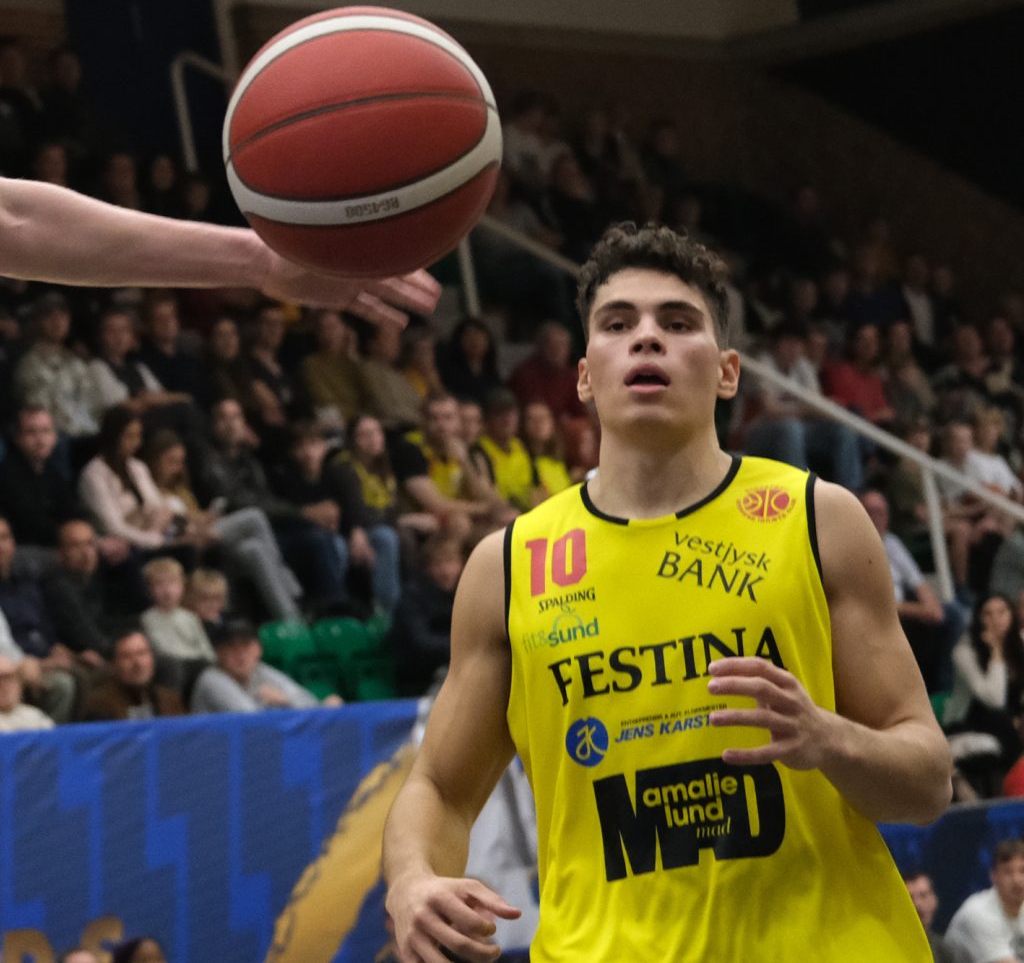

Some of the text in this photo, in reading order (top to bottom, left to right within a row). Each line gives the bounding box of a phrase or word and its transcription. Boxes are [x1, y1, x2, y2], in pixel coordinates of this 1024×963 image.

[525, 528, 588, 598] 10
[674, 531, 772, 572] vestjysk
[657, 550, 766, 604] BANK
[538, 586, 597, 614] SPALDING
[547, 626, 789, 707] FESTINA
[615, 714, 712, 743] JENS KARST
[664, 796, 725, 828] lund
